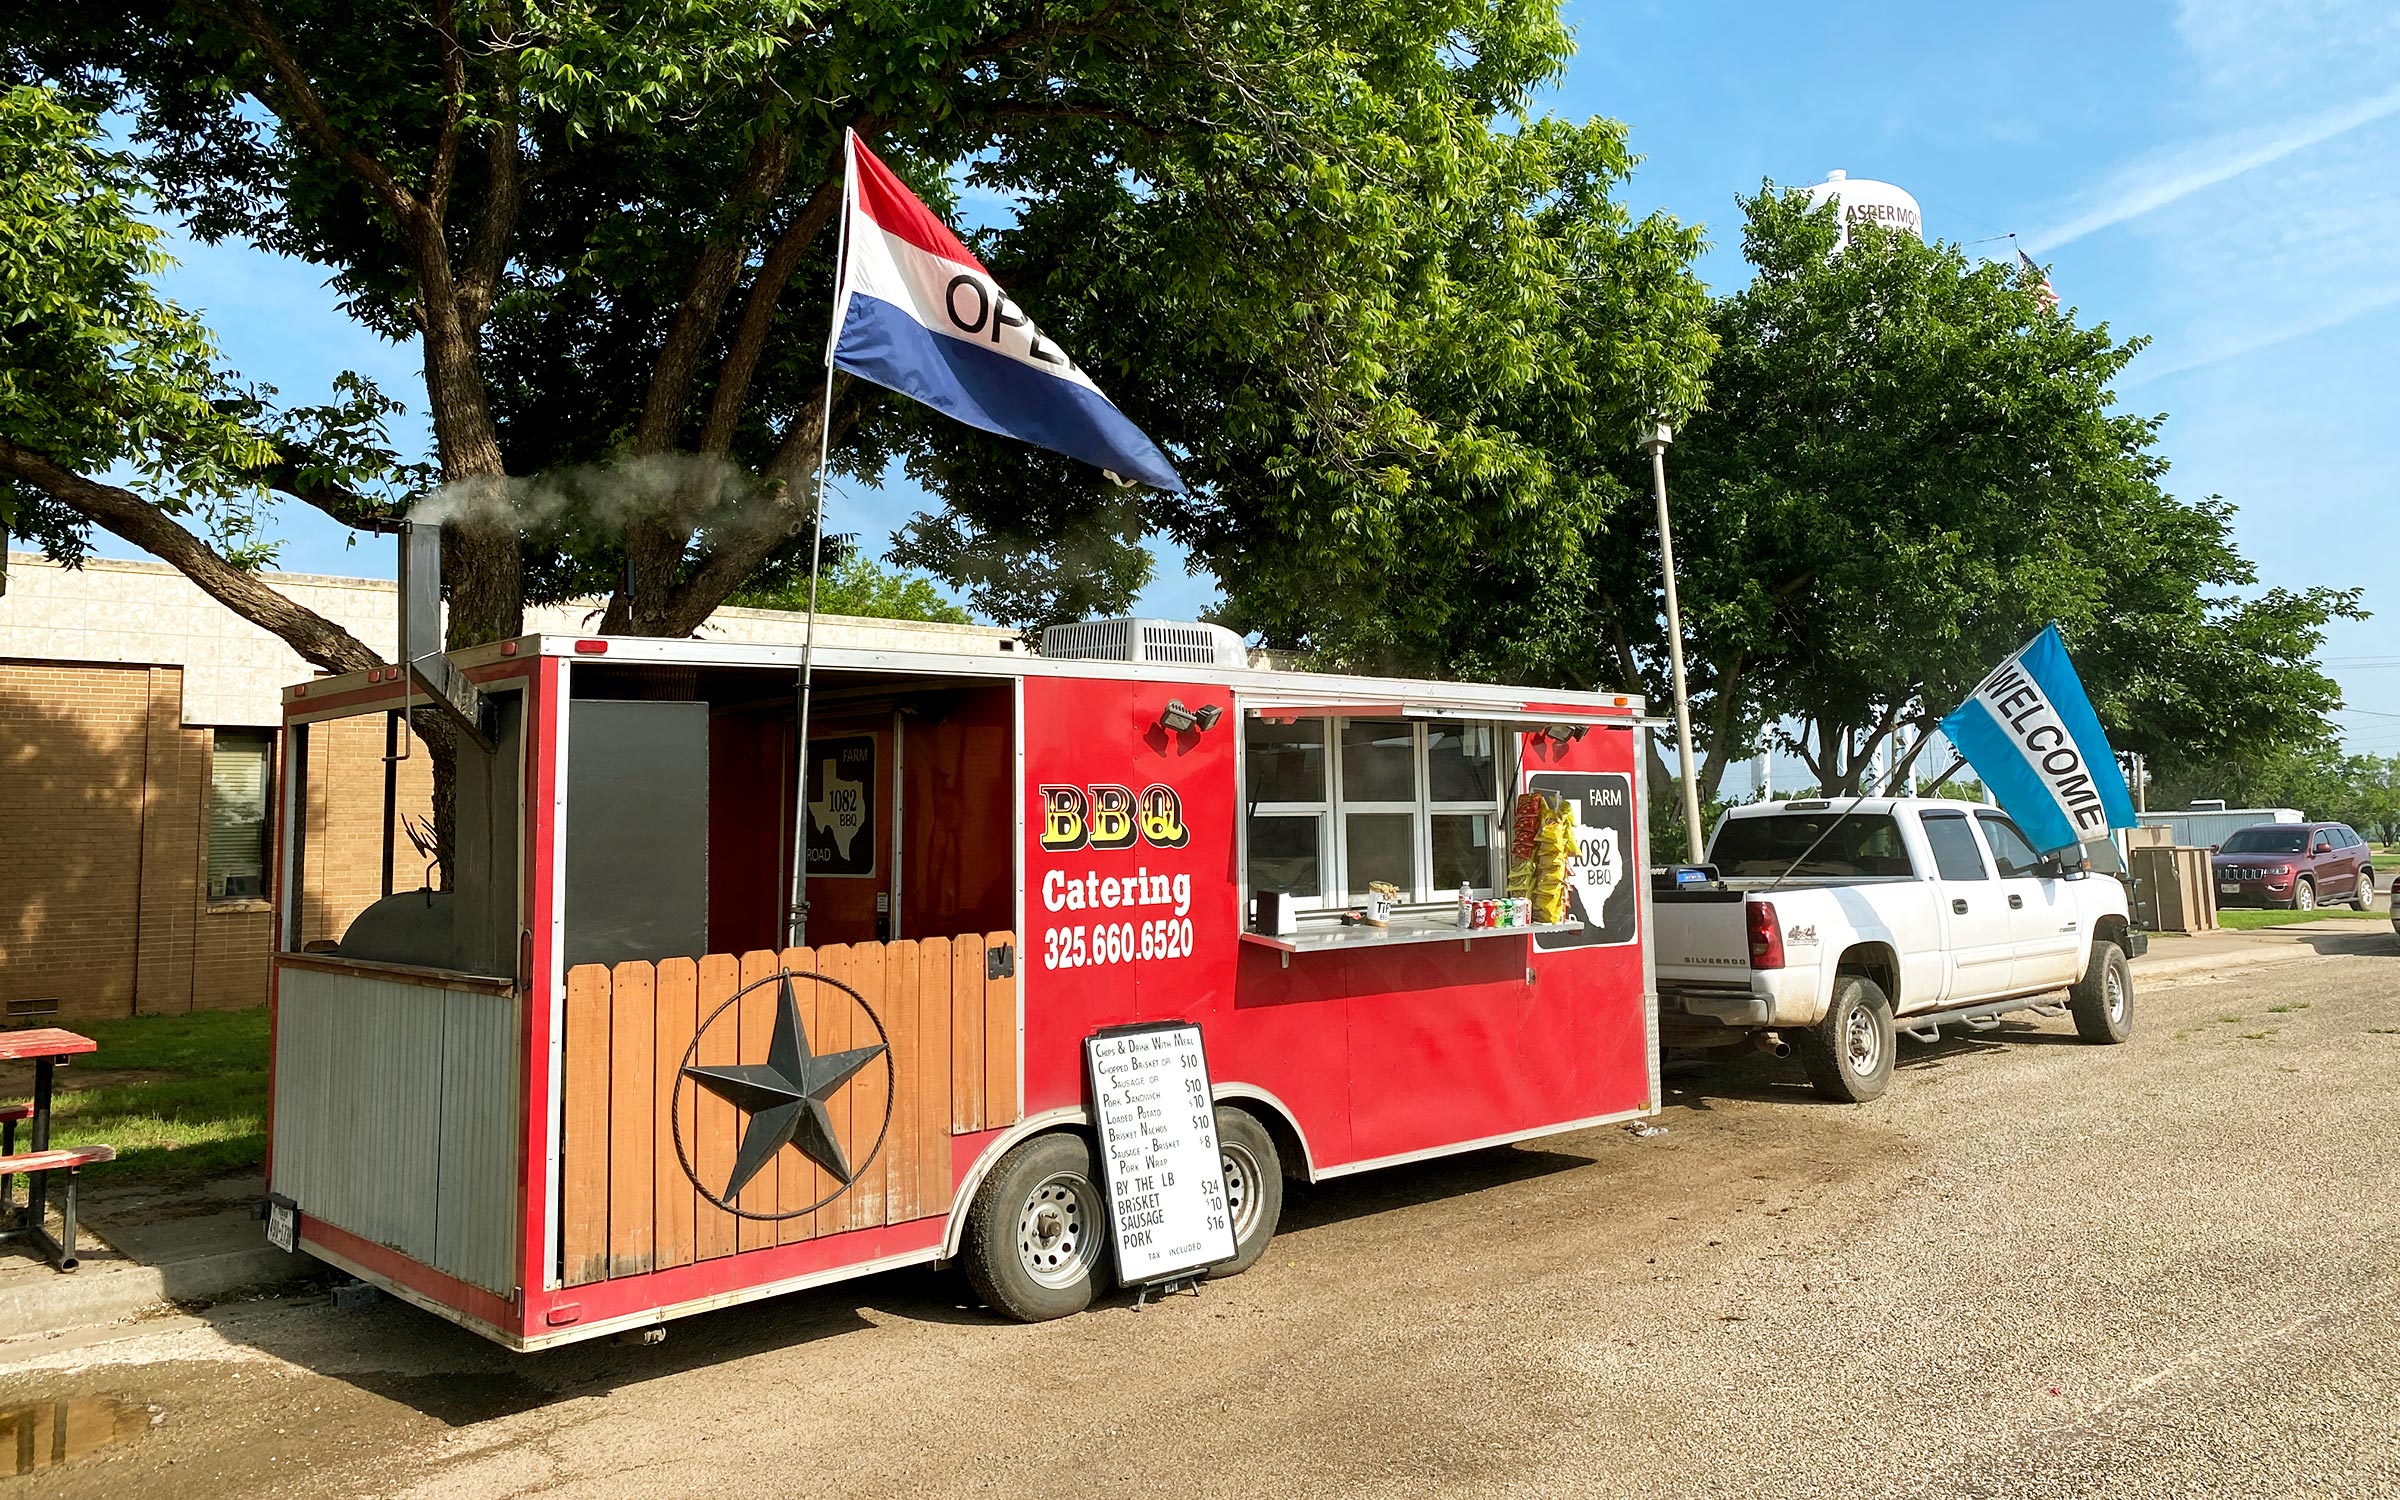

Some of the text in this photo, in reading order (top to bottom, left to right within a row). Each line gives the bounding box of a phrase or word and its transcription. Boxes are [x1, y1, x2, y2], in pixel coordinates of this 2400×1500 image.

[946, 274, 1076, 372] OPE
[843, 749, 867, 762] FARM
[1984, 665, 2104, 830] WELCOME
[829, 789, 857, 812] 1082
[1589, 789, 1622, 806] FARM
[840, 813, 857, 827] BBQ
[1039, 783, 1190, 852] BBQ
[807, 848, 831, 862] ROAD
[1588, 869, 1611, 885] BBQ
[1042, 867, 1191, 917] Catering
[1044, 918, 1193, 970] 325.660.6520
[1684, 957, 1746, 965] SILVERADO
[1118, 1041, 1126, 1054] &
[1181, 1054, 1198, 1069] $10
[1185, 1078, 1202, 1093] $10
[1189, 1094, 1205, 1108] $10
[1192, 1115, 1209, 1129] $10
[1200, 1135, 1211, 1149] $8
[1116, 1172, 1175, 1196] BY THE LB
[1201, 1179, 1219, 1196] $24
[1121, 1196, 1222, 1232] SAUSAGE $10
[1123, 1215, 1225, 1250] PORK $16
[1149, 1242, 1202, 1261] TAX INCLUDED
